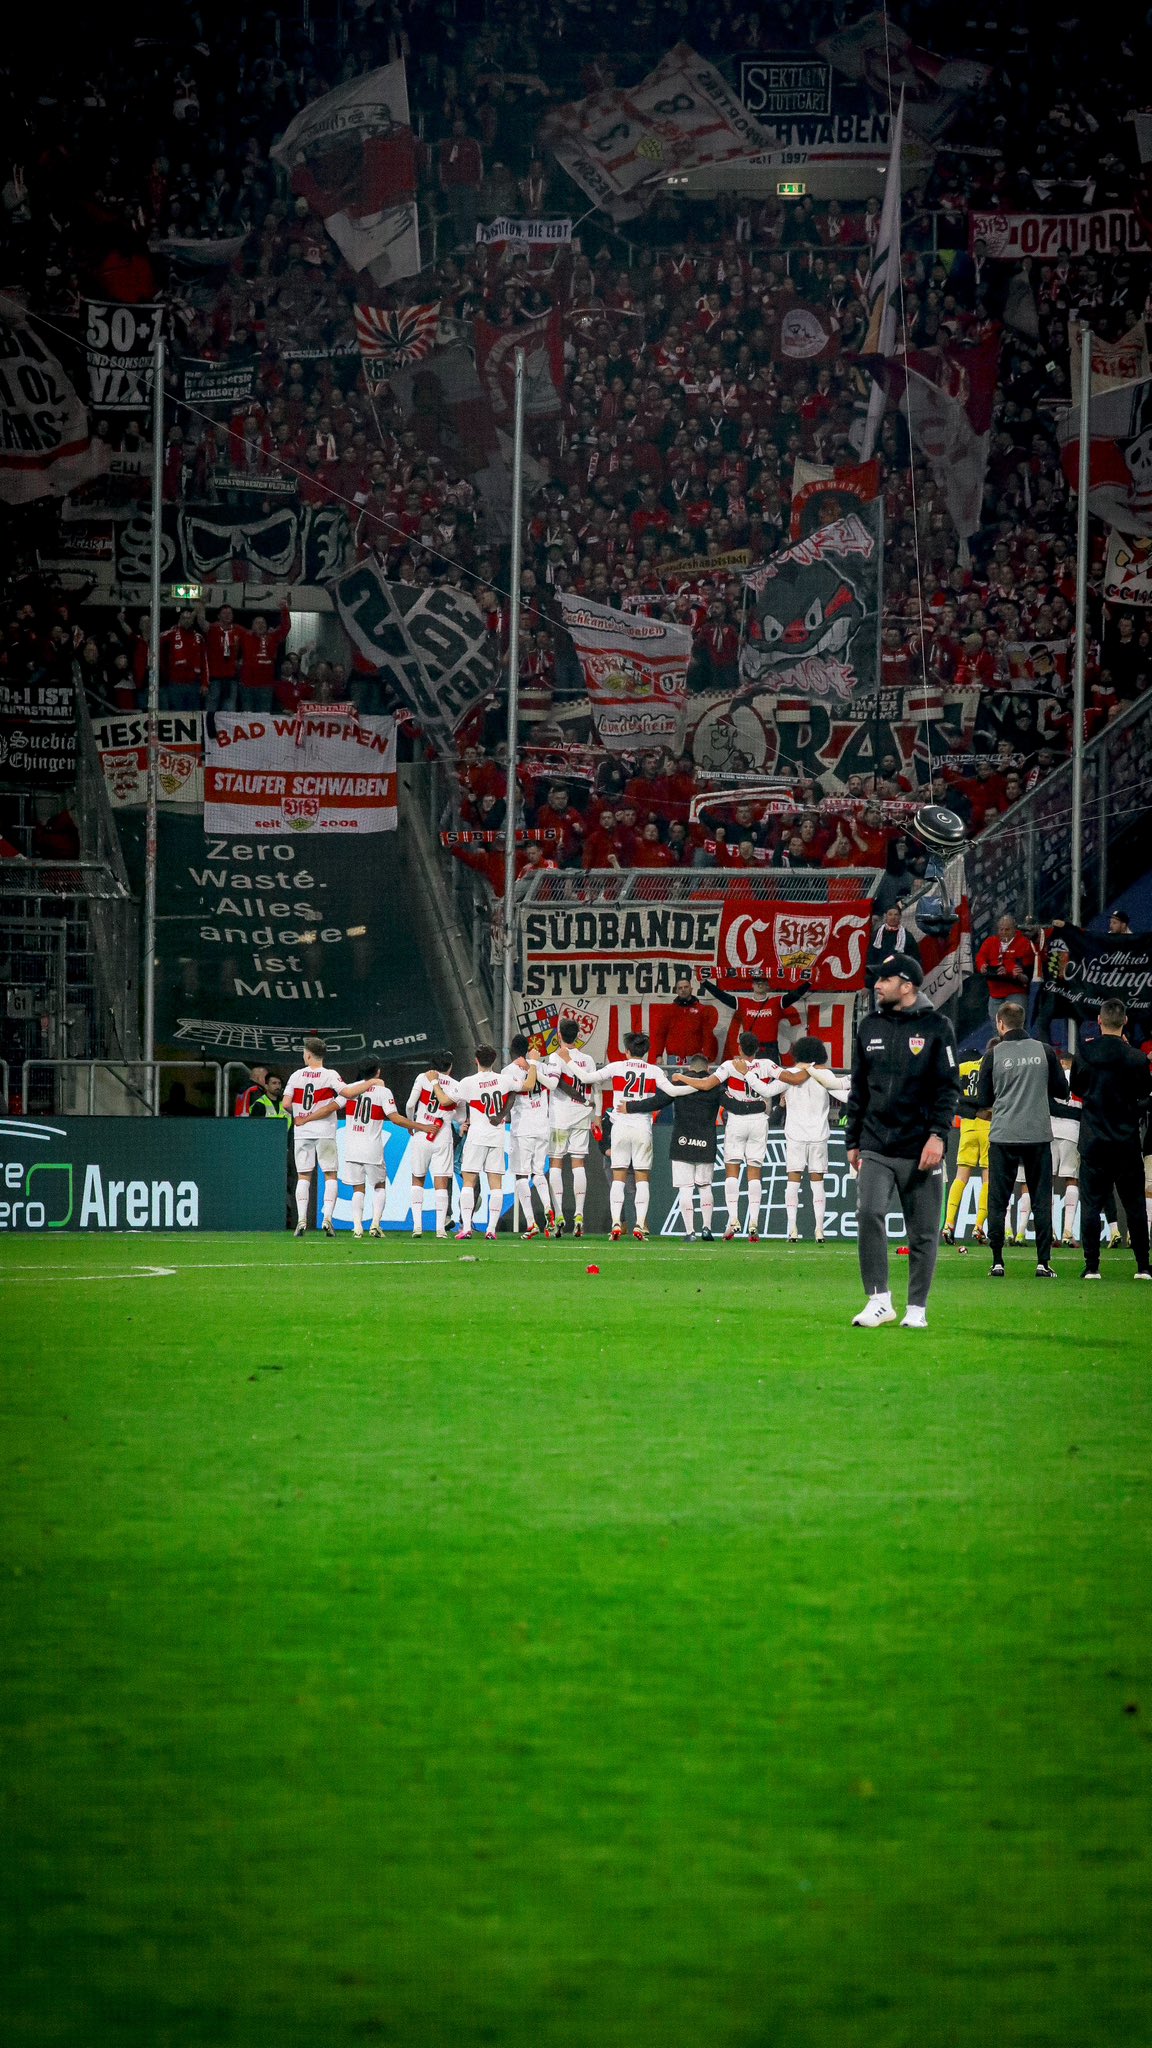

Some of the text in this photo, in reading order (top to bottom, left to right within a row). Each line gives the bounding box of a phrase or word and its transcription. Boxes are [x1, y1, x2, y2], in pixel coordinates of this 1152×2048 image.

[775, 115, 889, 146] HWABEN
[781, 152, 808, 164] 1997
[528, 224, 542, 238] DIE
[547, 224, 568, 238] LEBT
[1021, 218, 1079, 254] 0711
[86, 304, 168, 352] 50+1
[87, 367, 154, 404] VIX!
[38, 687, 74, 706] IST
[0, 704, 73, 717] ANTASTBAR!
[215, 720, 390, 755] BAD WMPFEN
[214, 772, 389, 798] STAUFER SCHWABEN
[254, 818, 358, 829] seit 2008
[206, 840, 295, 861] Zero
[216, 897, 315, 917] Alles
[199, 925, 343, 945] andere
[526, 909, 719, 950] SÜDBANDE
[252, 953, 304, 973] ist
[1099, 950, 1149, 966] Altkreis
[233, 978, 338, 1000] Müll.
[526, 963, 717, 996] STUTTGAR
[577, 997, 590, 1009] 07
[372, 1032, 428, 1050] Arena
[1016, 1056, 1042, 1067] JAKO
[623, 1070, 646, 1099] 21
[302, 1082, 315, 1111] 6
[480, 1090, 504, 1119] 20
[354, 1093, 372, 1125] 10
[687, 1137, 707, 1149] JAKO
[79, 1164, 199, 1228] Arena
